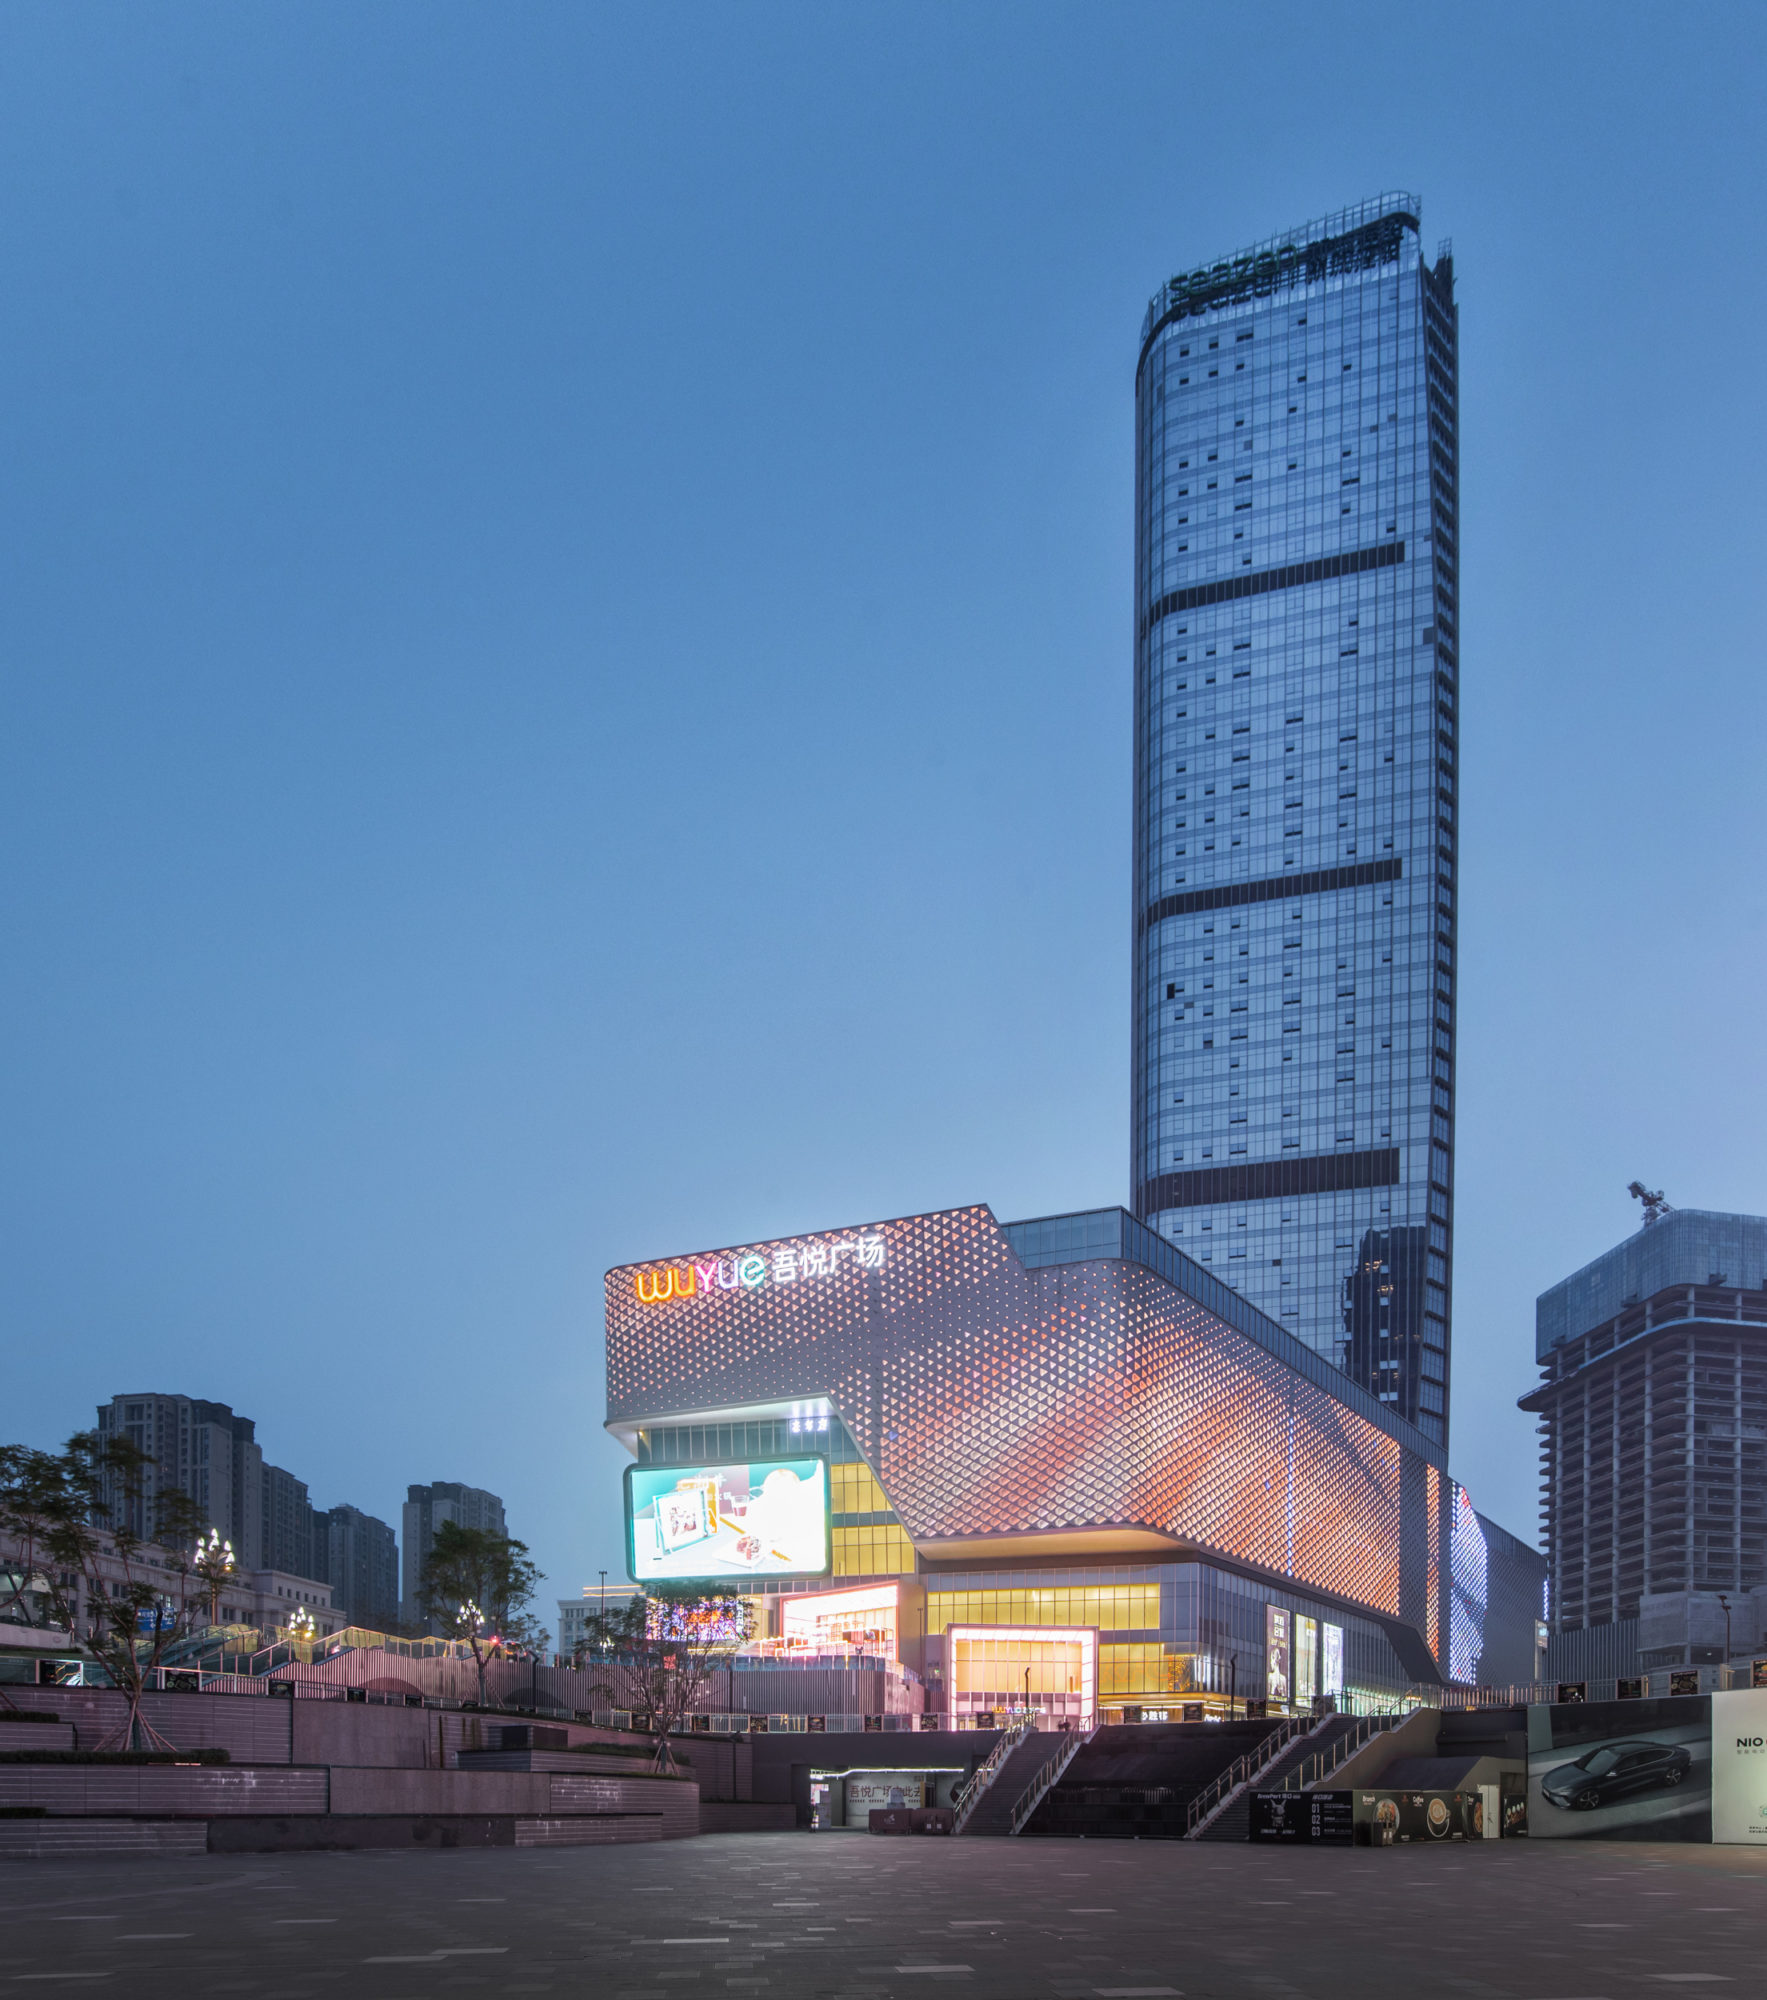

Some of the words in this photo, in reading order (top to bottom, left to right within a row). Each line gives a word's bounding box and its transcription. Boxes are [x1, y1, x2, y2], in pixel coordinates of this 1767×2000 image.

[772, 1236, 884, 1283] 吾悦广场
[1737, 1737, 1764, 1748] NIO
[849, 1785, 921, 1798] 吾悦广场此去
[1311, 1803, 1320, 1813] 01
[1311, 1815, 1321, 1825] 02
[1311, 1826, 1321, 1836] 03
